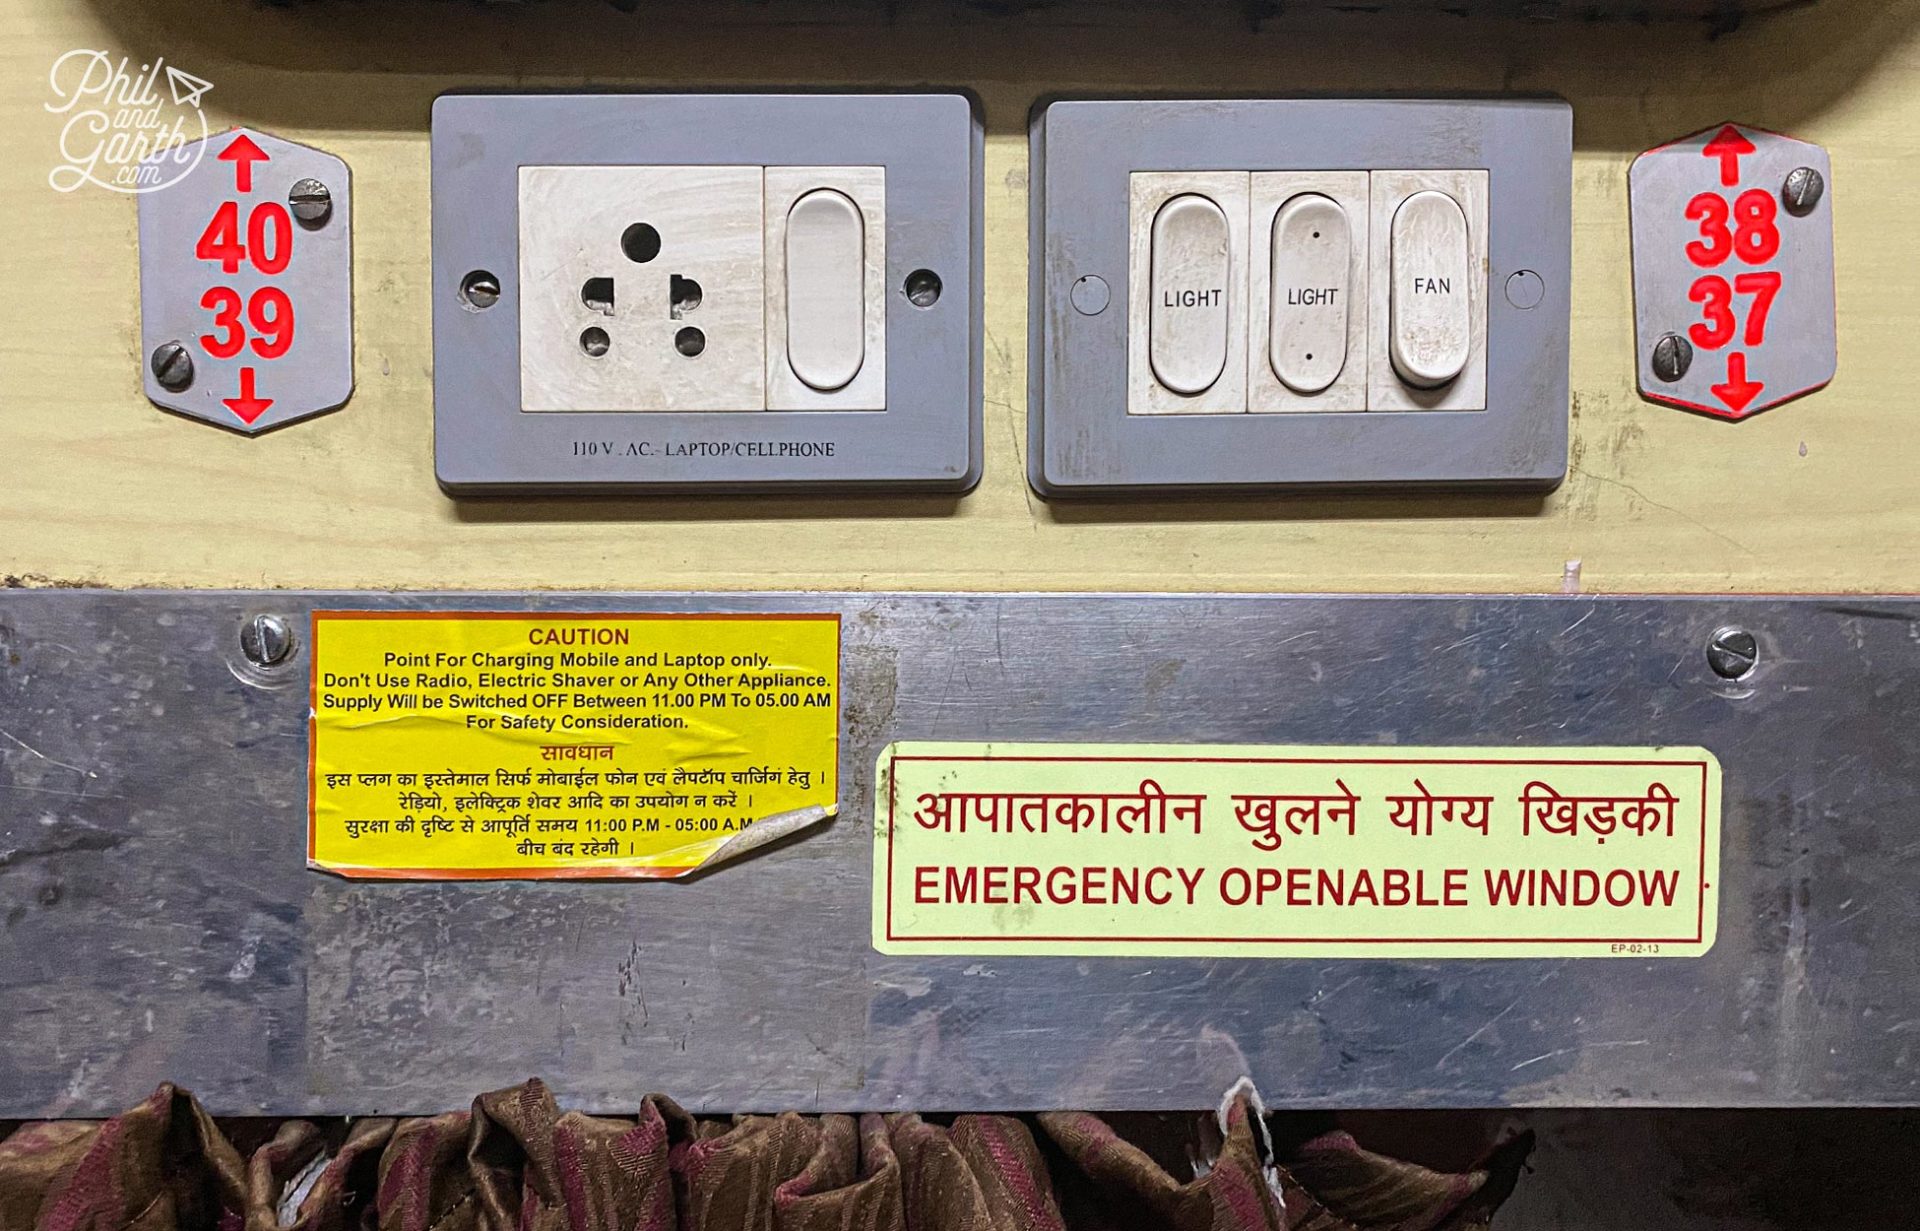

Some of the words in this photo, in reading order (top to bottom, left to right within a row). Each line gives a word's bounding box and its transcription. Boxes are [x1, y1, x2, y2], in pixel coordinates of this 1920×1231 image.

[1685, 188, 1780, 267] 38
[196, 202, 292, 274] 40
[1414, 278, 1450, 294] FAN
[1164, 289, 1222, 308] LIGHT
[1287, 288, 1338, 306] LIGHT
[1688, 272, 1781, 350] 37
[200, 286, 294, 359] 39
[574, 442, 597, 455] 110
[529, 628, 629, 646] CAUTION
[385, 653, 430, 667] Point
[436, 653, 467, 667] For
[472, 653, 554, 670] Charging
[560, 652, 619, 667] Mobile
[625, 653, 657, 667] and
[664, 653, 724, 669] Laptop
[731, 653, 772, 670] only.
[324, 673, 370, 688] Don't
[376, 673, 410, 688] Use
[416, 673, 472, 690] Radio,
[479, 673, 546, 688] Electric
[552, 673, 615, 688] Shaver
[620, 675, 639, 687] or
[644, 673, 678, 690] Any
[685, 673, 734, 687] Other
[738, 673, 831, 690] Appliance.
[324, 694, 382, 711] Supply
[388, 694, 417, 709] Will
[422, 694, 443, 709] be
[449, 694, 527, 708] Switched
[532, 694, 568, 708] OFF
[574, 694, 647, 708] Between
[653, 694, 694, 707] 11.00
[700, 694, 726, 707] PM
[732, 693, 751, 707] To
[756, 693, 799, 707] 05.00
[804, 693, 831, 706] AM
[467, 715, 496, 729] For
[501, 715, 555, 732] Safety
[561, 714, 688, 729] Consideration.
[541, 745, 614, 762] सावधान
[325, 774, 352, 788] इस
[358, 774, 391, 787] प्लग
[397, 774, 417, 786] का
[424, 768, 489, 789] इस्तेमाल
[496, 768, 531, 787] सिर्फ
[536, 767, 599, 788] मोबाईल
[605, 768, 637, 785] फोन
[645, 769, 666, 785] एवं
[673, 766, 725, 785] लैपटॉप
[788, 767, 811, 789] हेतु
[398, 791, 447, 813] रेडियो,
[527, 791, 561, 809] शेवर
[568, 792, 602, 809] आदि
[610, 795, 630, 808] का
[636, 791, 689, 808] उपयोग
[694, 794, 705, 808] न
[713, 790, 738, 808] करें
[914, 778, 1207, 834] आपातकालीन
[1230, 778, 1361, 851] खुलने
[1386, 778, 1494, 836] योग्य
[1518, 781, 1680, 844] खिड़की
[345, 820, 389, 838] सुरक्षा
[395, 815, 415, 833] की
[421, 815, 454, 837] दृष्टि
[460, 815, 474, 833] से
[481, 814, 530, 837] आपूर्ति
[537, 819, 578, 833] समय
[586, 819, 627, 832] 11:00
[633, 819, 660, 832] P.M
[675, 819, 718, 831] 05:00
[516, 838, 546, 855] बीच
[552, 839, 574, 856] बंद
[581, 837, 619, 856] रहेगी
[915, 866, 1205, 905] EMERGENCY
[1219, 867, 1468, 906] OPENABLE
[1485, 869, 1680, 906] WINDOW
[1612, 944, 1659, 953] EP-02-13
